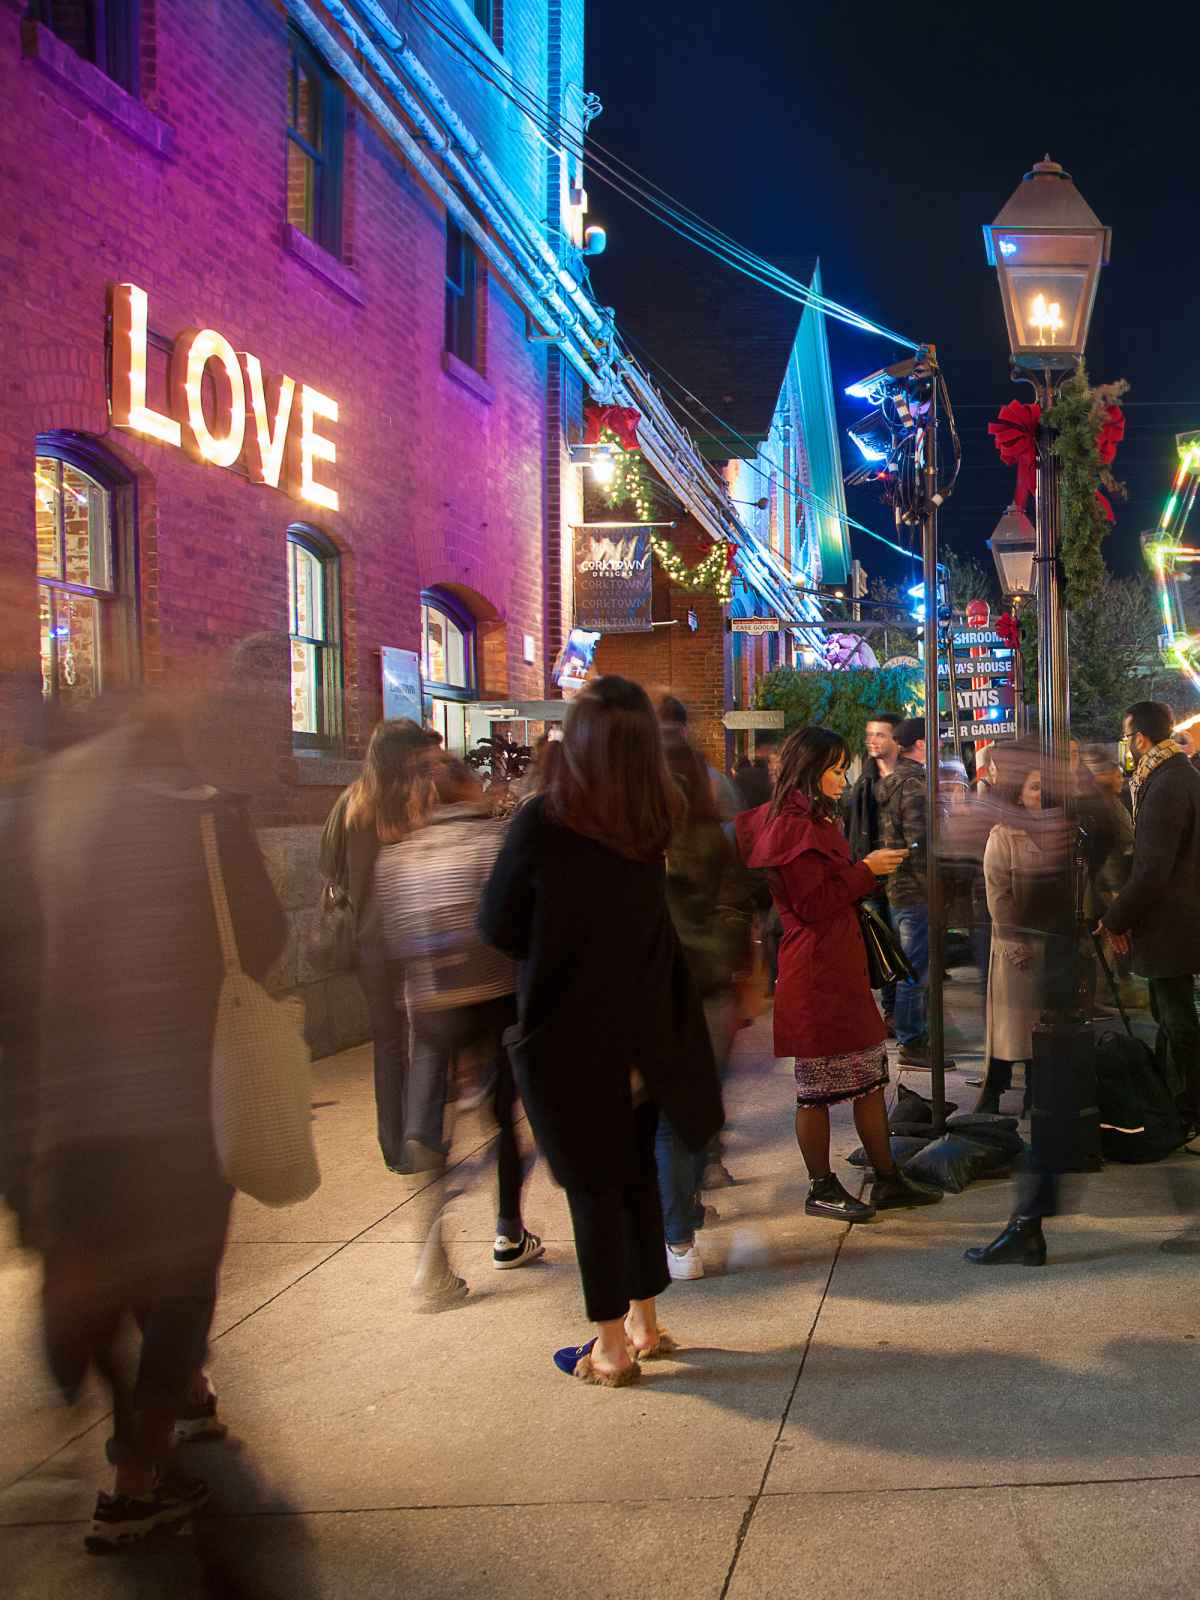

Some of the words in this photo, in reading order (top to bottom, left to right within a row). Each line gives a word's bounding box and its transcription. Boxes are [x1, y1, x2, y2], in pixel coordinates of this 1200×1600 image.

[112, 283, 340, 512] LOVE
[580, 560, 645, 570] CORKTOWN
[938, 663, 974, 674] ANTA'S
[977, 661, 1012, 673] HOUSE
[971, 722, 1015, 736] GARDEN
